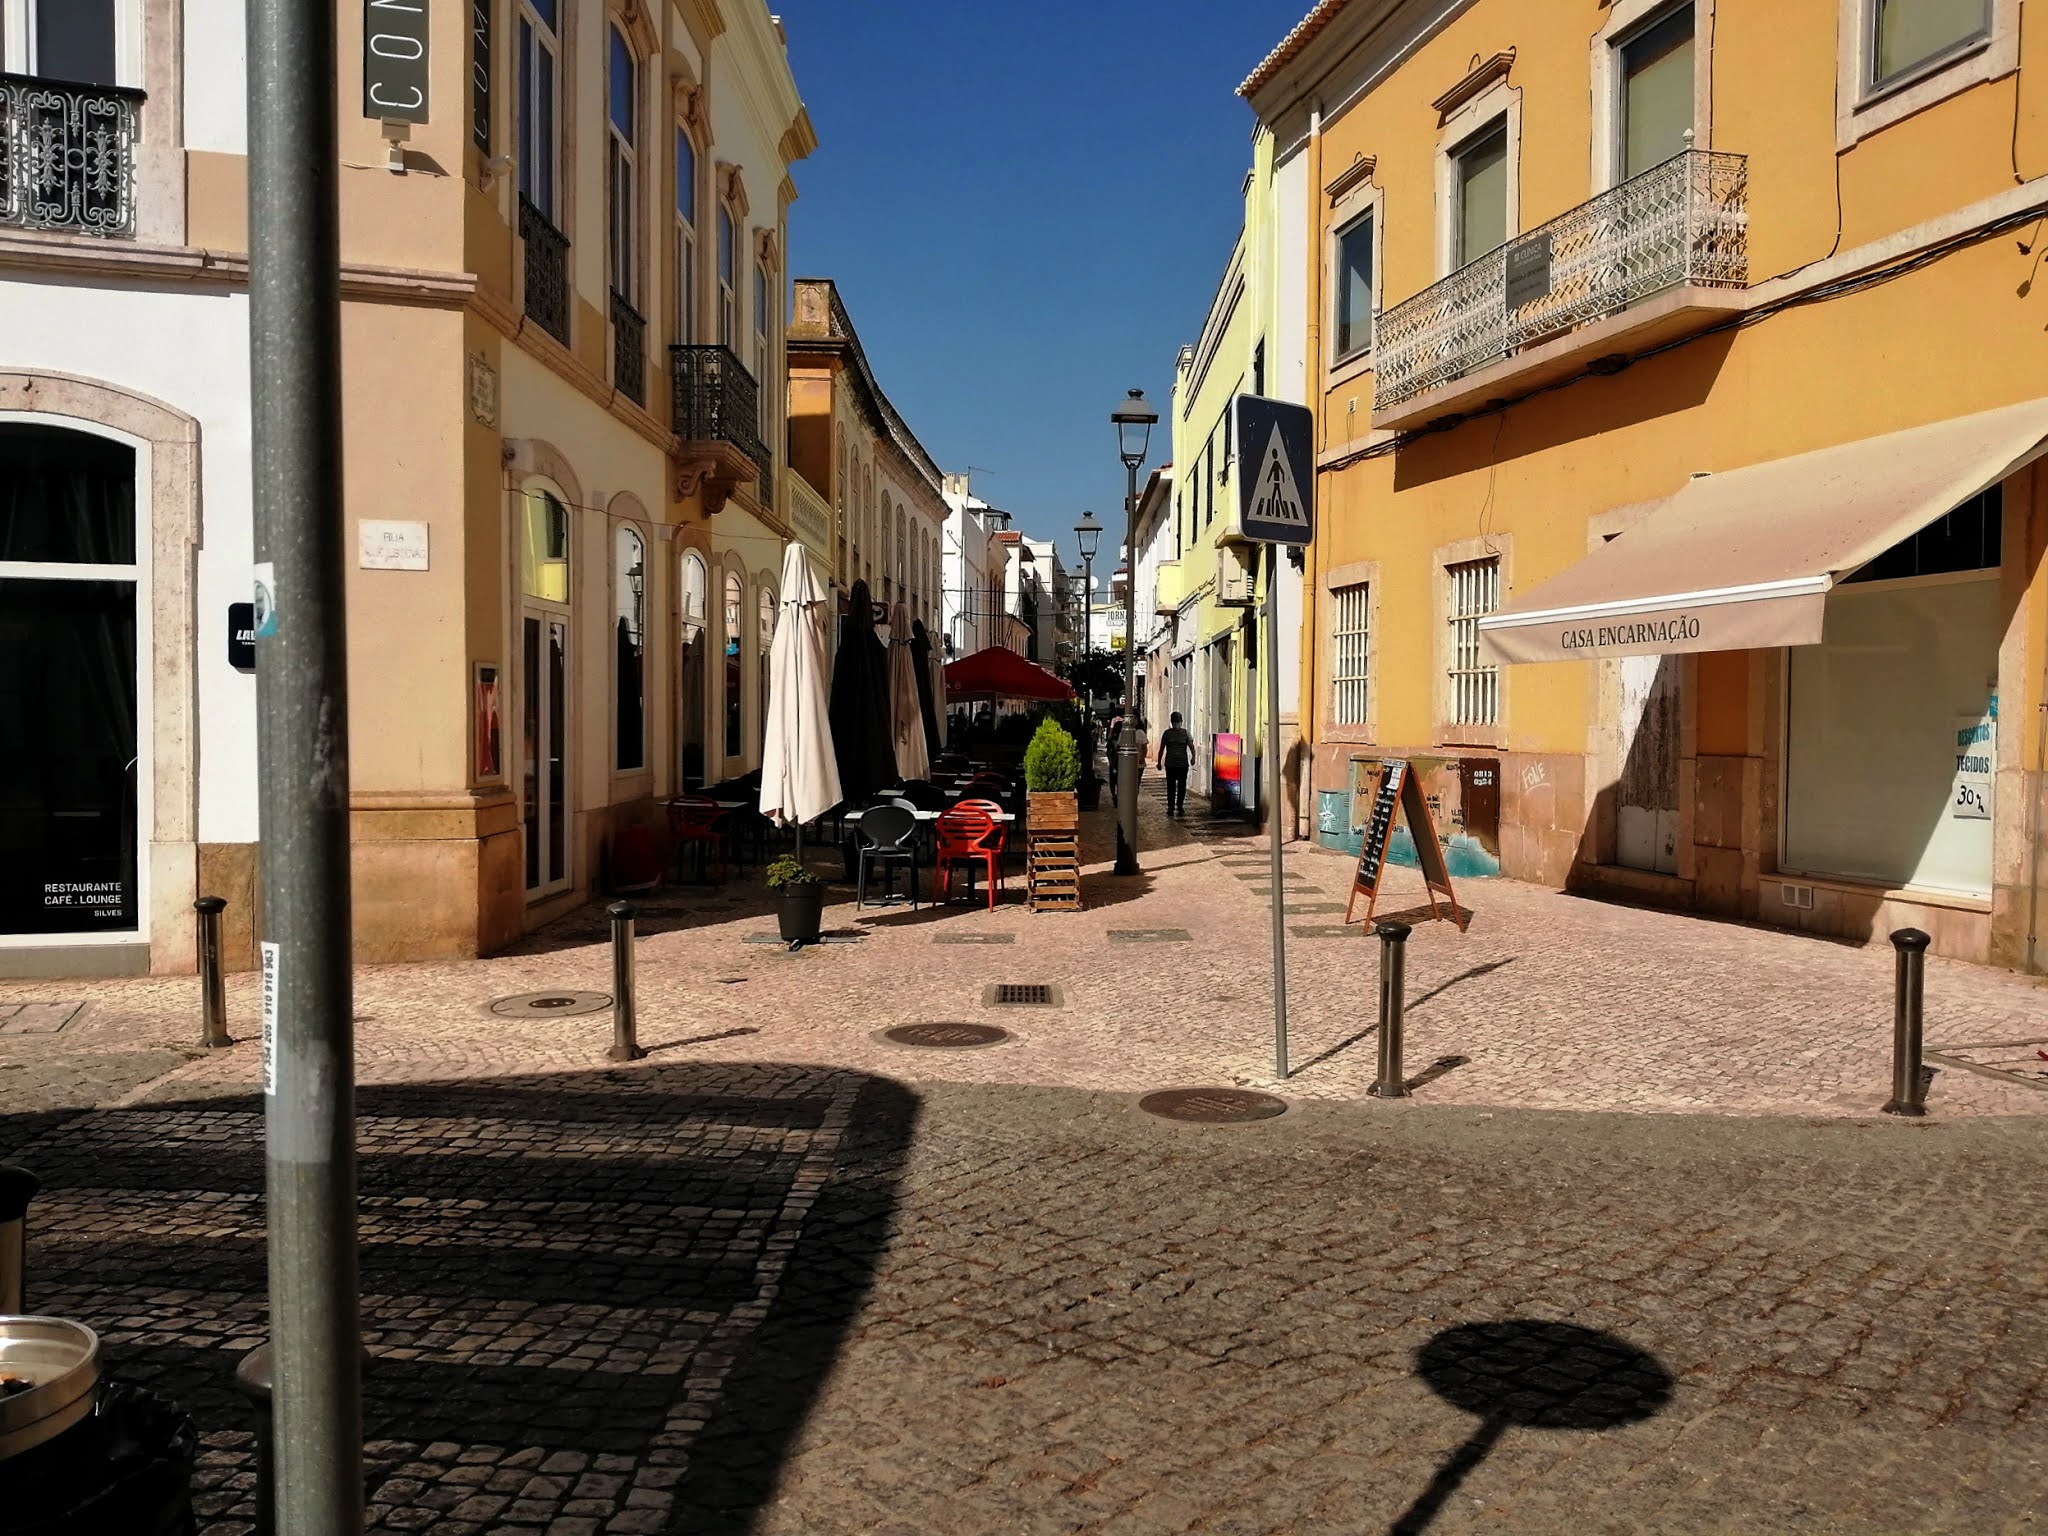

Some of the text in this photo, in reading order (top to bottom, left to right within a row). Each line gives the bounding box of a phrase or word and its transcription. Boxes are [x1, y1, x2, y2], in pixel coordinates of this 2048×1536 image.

[1561, 614, 1701, 649] CASA ENCARNAÇÃO
[1956, 755, 1990, 774] TECIDOS
[44, 882, 122, 893] RESTAURANTE
[44, 894, 73, 905] CAFÉ
[80, 894, 122, 904] LOUNGE
[94, 909, 122, 917] SILVES
[265, 995, 273, 1015] 910
